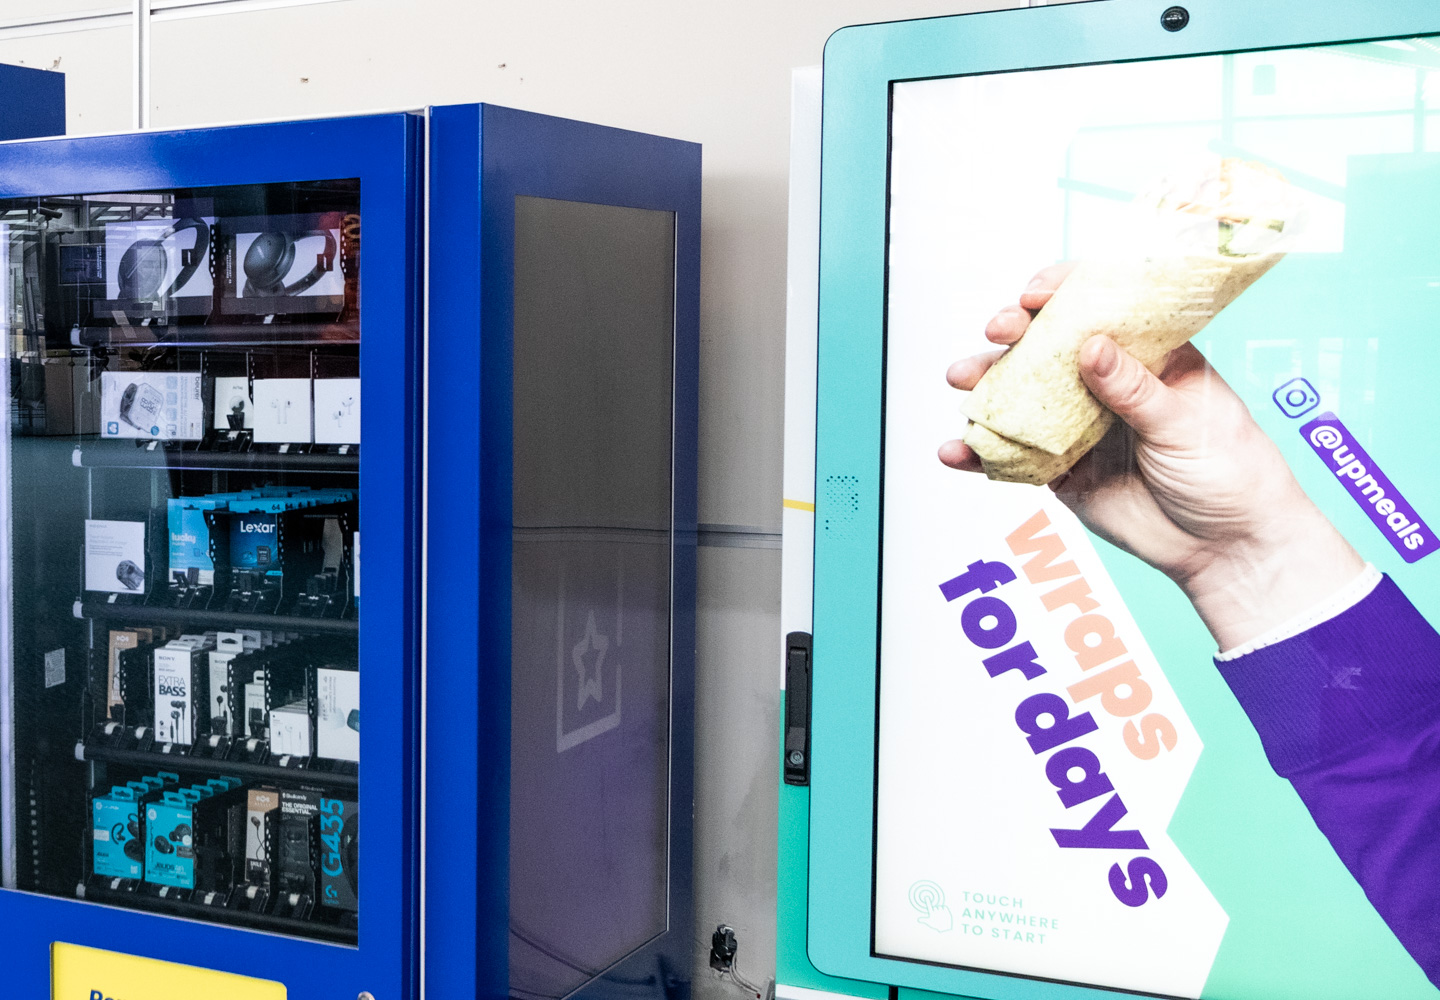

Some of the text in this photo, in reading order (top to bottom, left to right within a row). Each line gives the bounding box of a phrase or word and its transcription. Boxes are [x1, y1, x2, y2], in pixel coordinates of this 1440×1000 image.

[1310, 425, 1424, 550] @upmeals
[240, 520, 276, 533] Lexar
[1004, 508, 1178, 761] wraps
[158, 675, 186, 687] EXTRA
[158, 685, 187, 697] BASS
[938, 559, 1168, 908] for days
[320, 798, 344, 877] G435
[962, 891, 1023, 909] TOUCH
[962, 907, 1059, 930] ANYWHERE
[962, 923, 1047, 945] TO START
